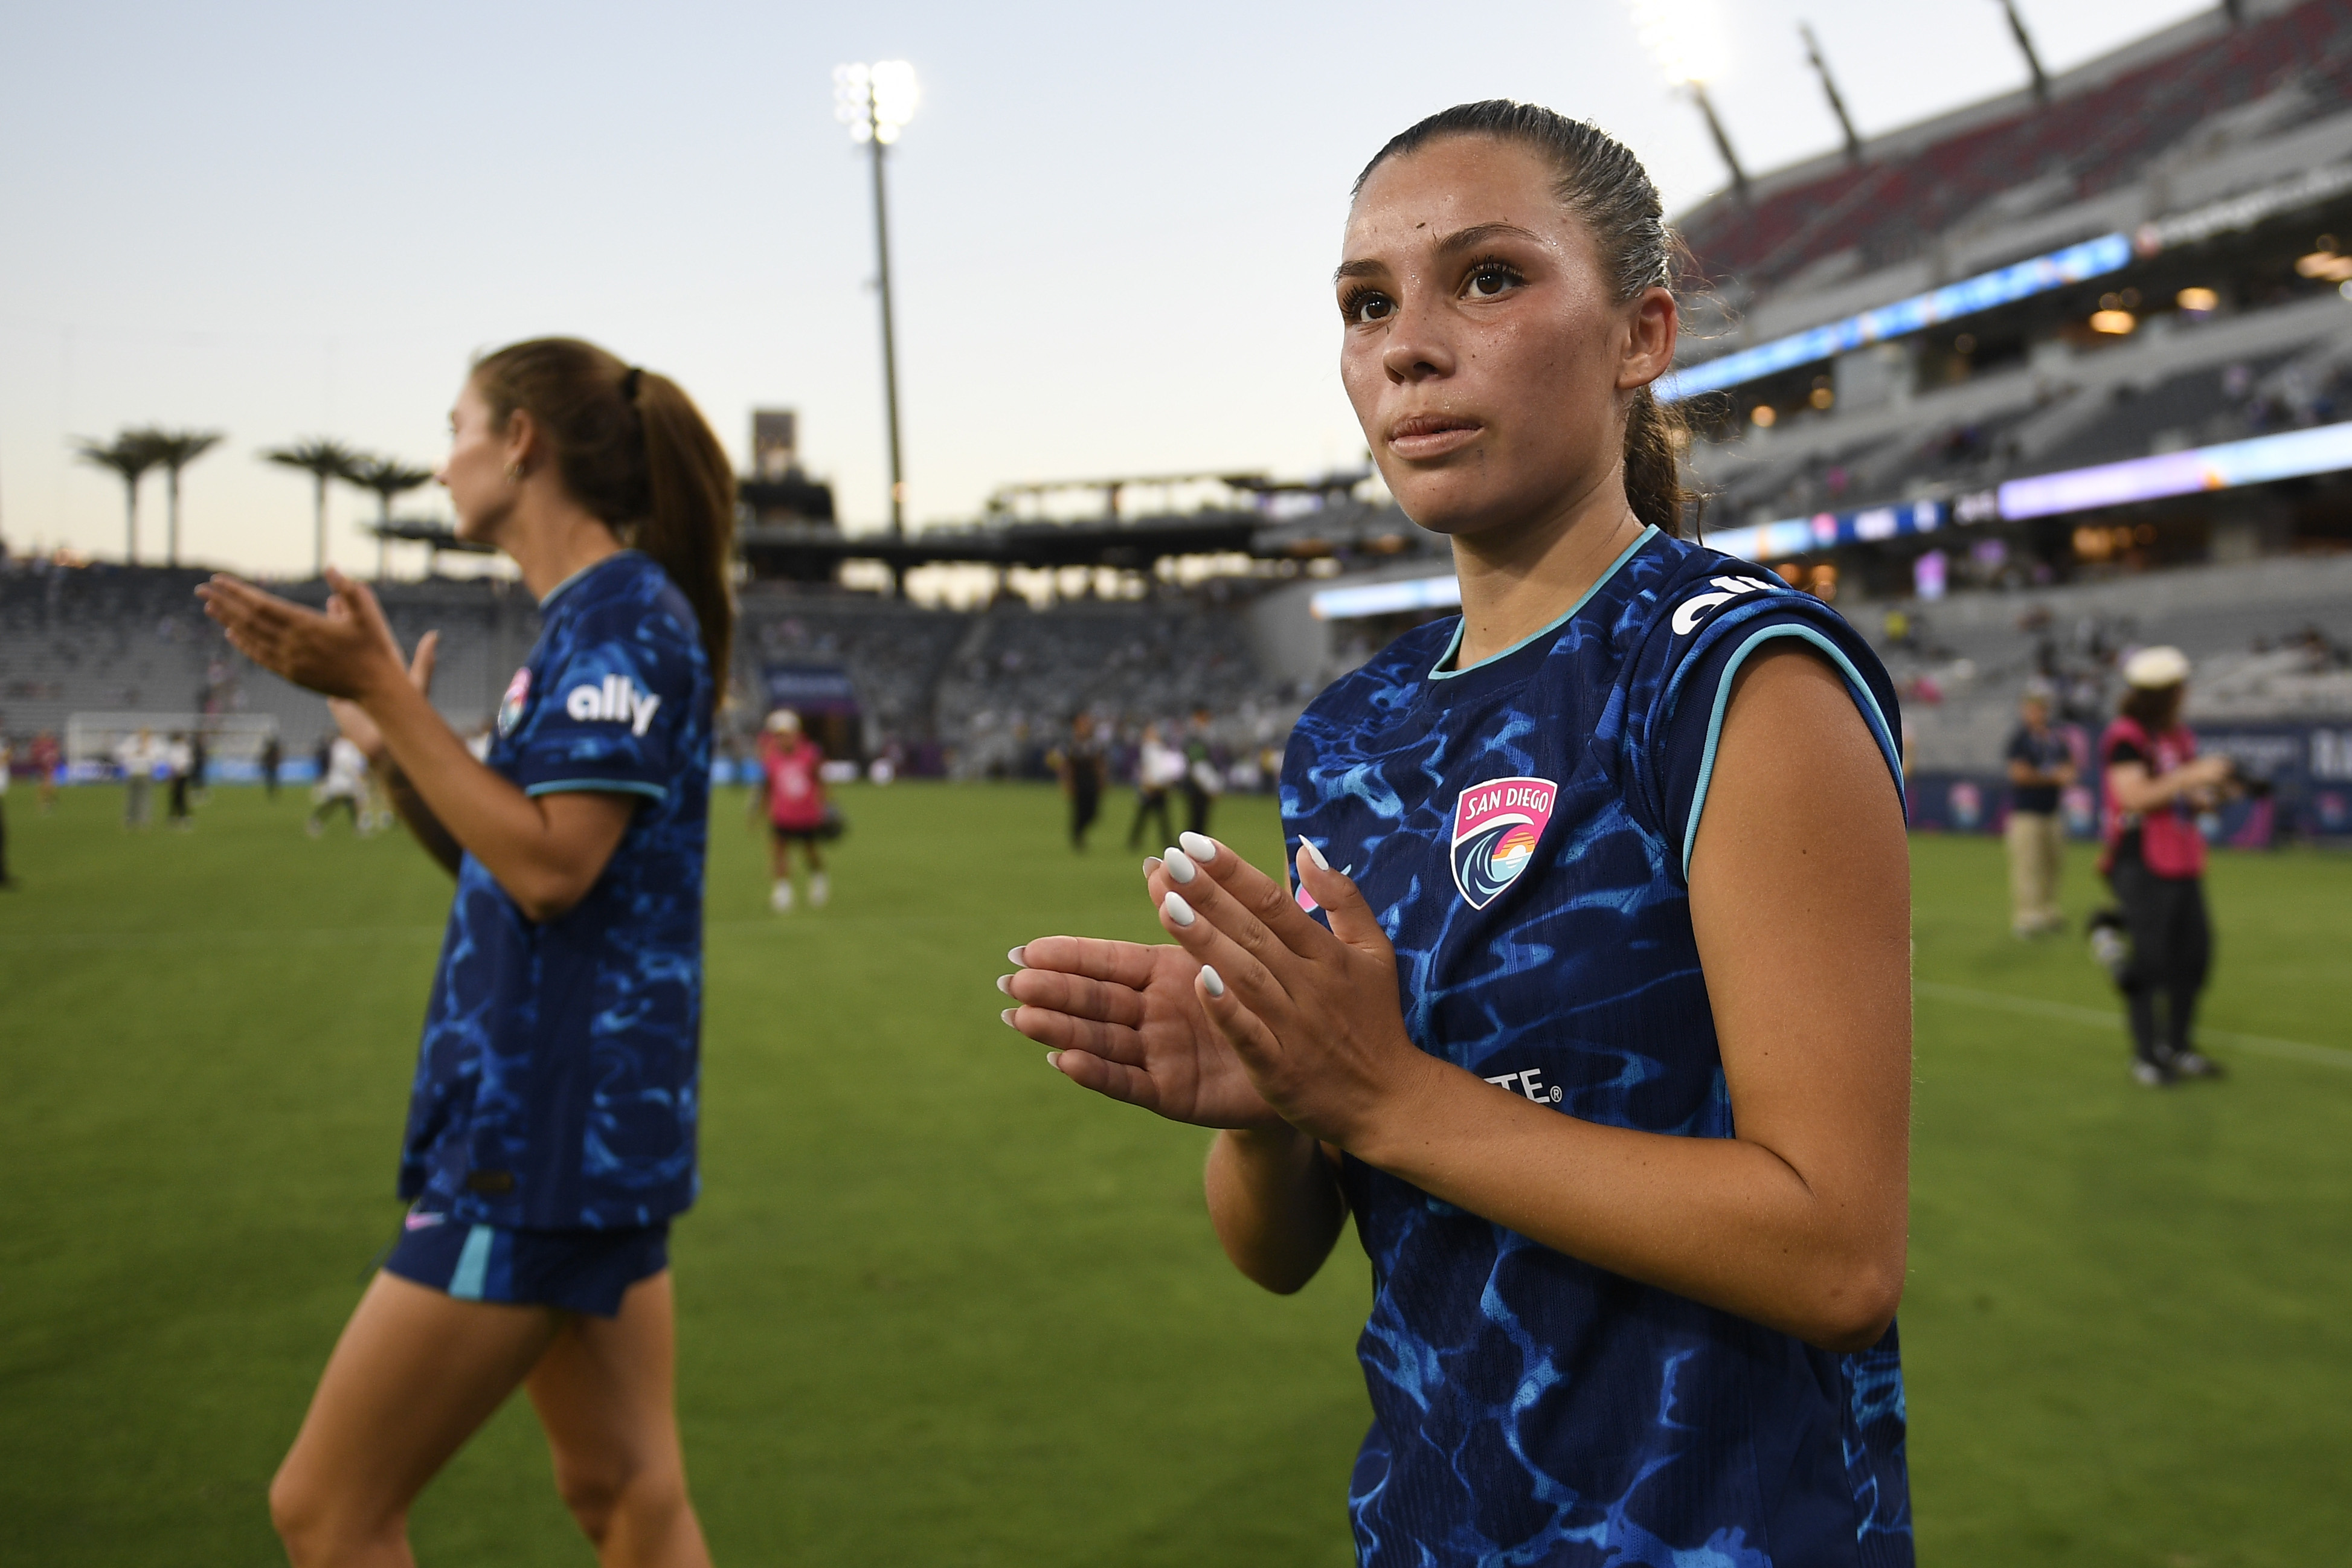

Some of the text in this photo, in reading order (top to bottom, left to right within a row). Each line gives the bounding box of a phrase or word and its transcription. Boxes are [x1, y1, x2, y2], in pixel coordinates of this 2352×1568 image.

[567, 673, 661, 737] ally
[1465, 787, 1549, 820] SAN DIEGO
